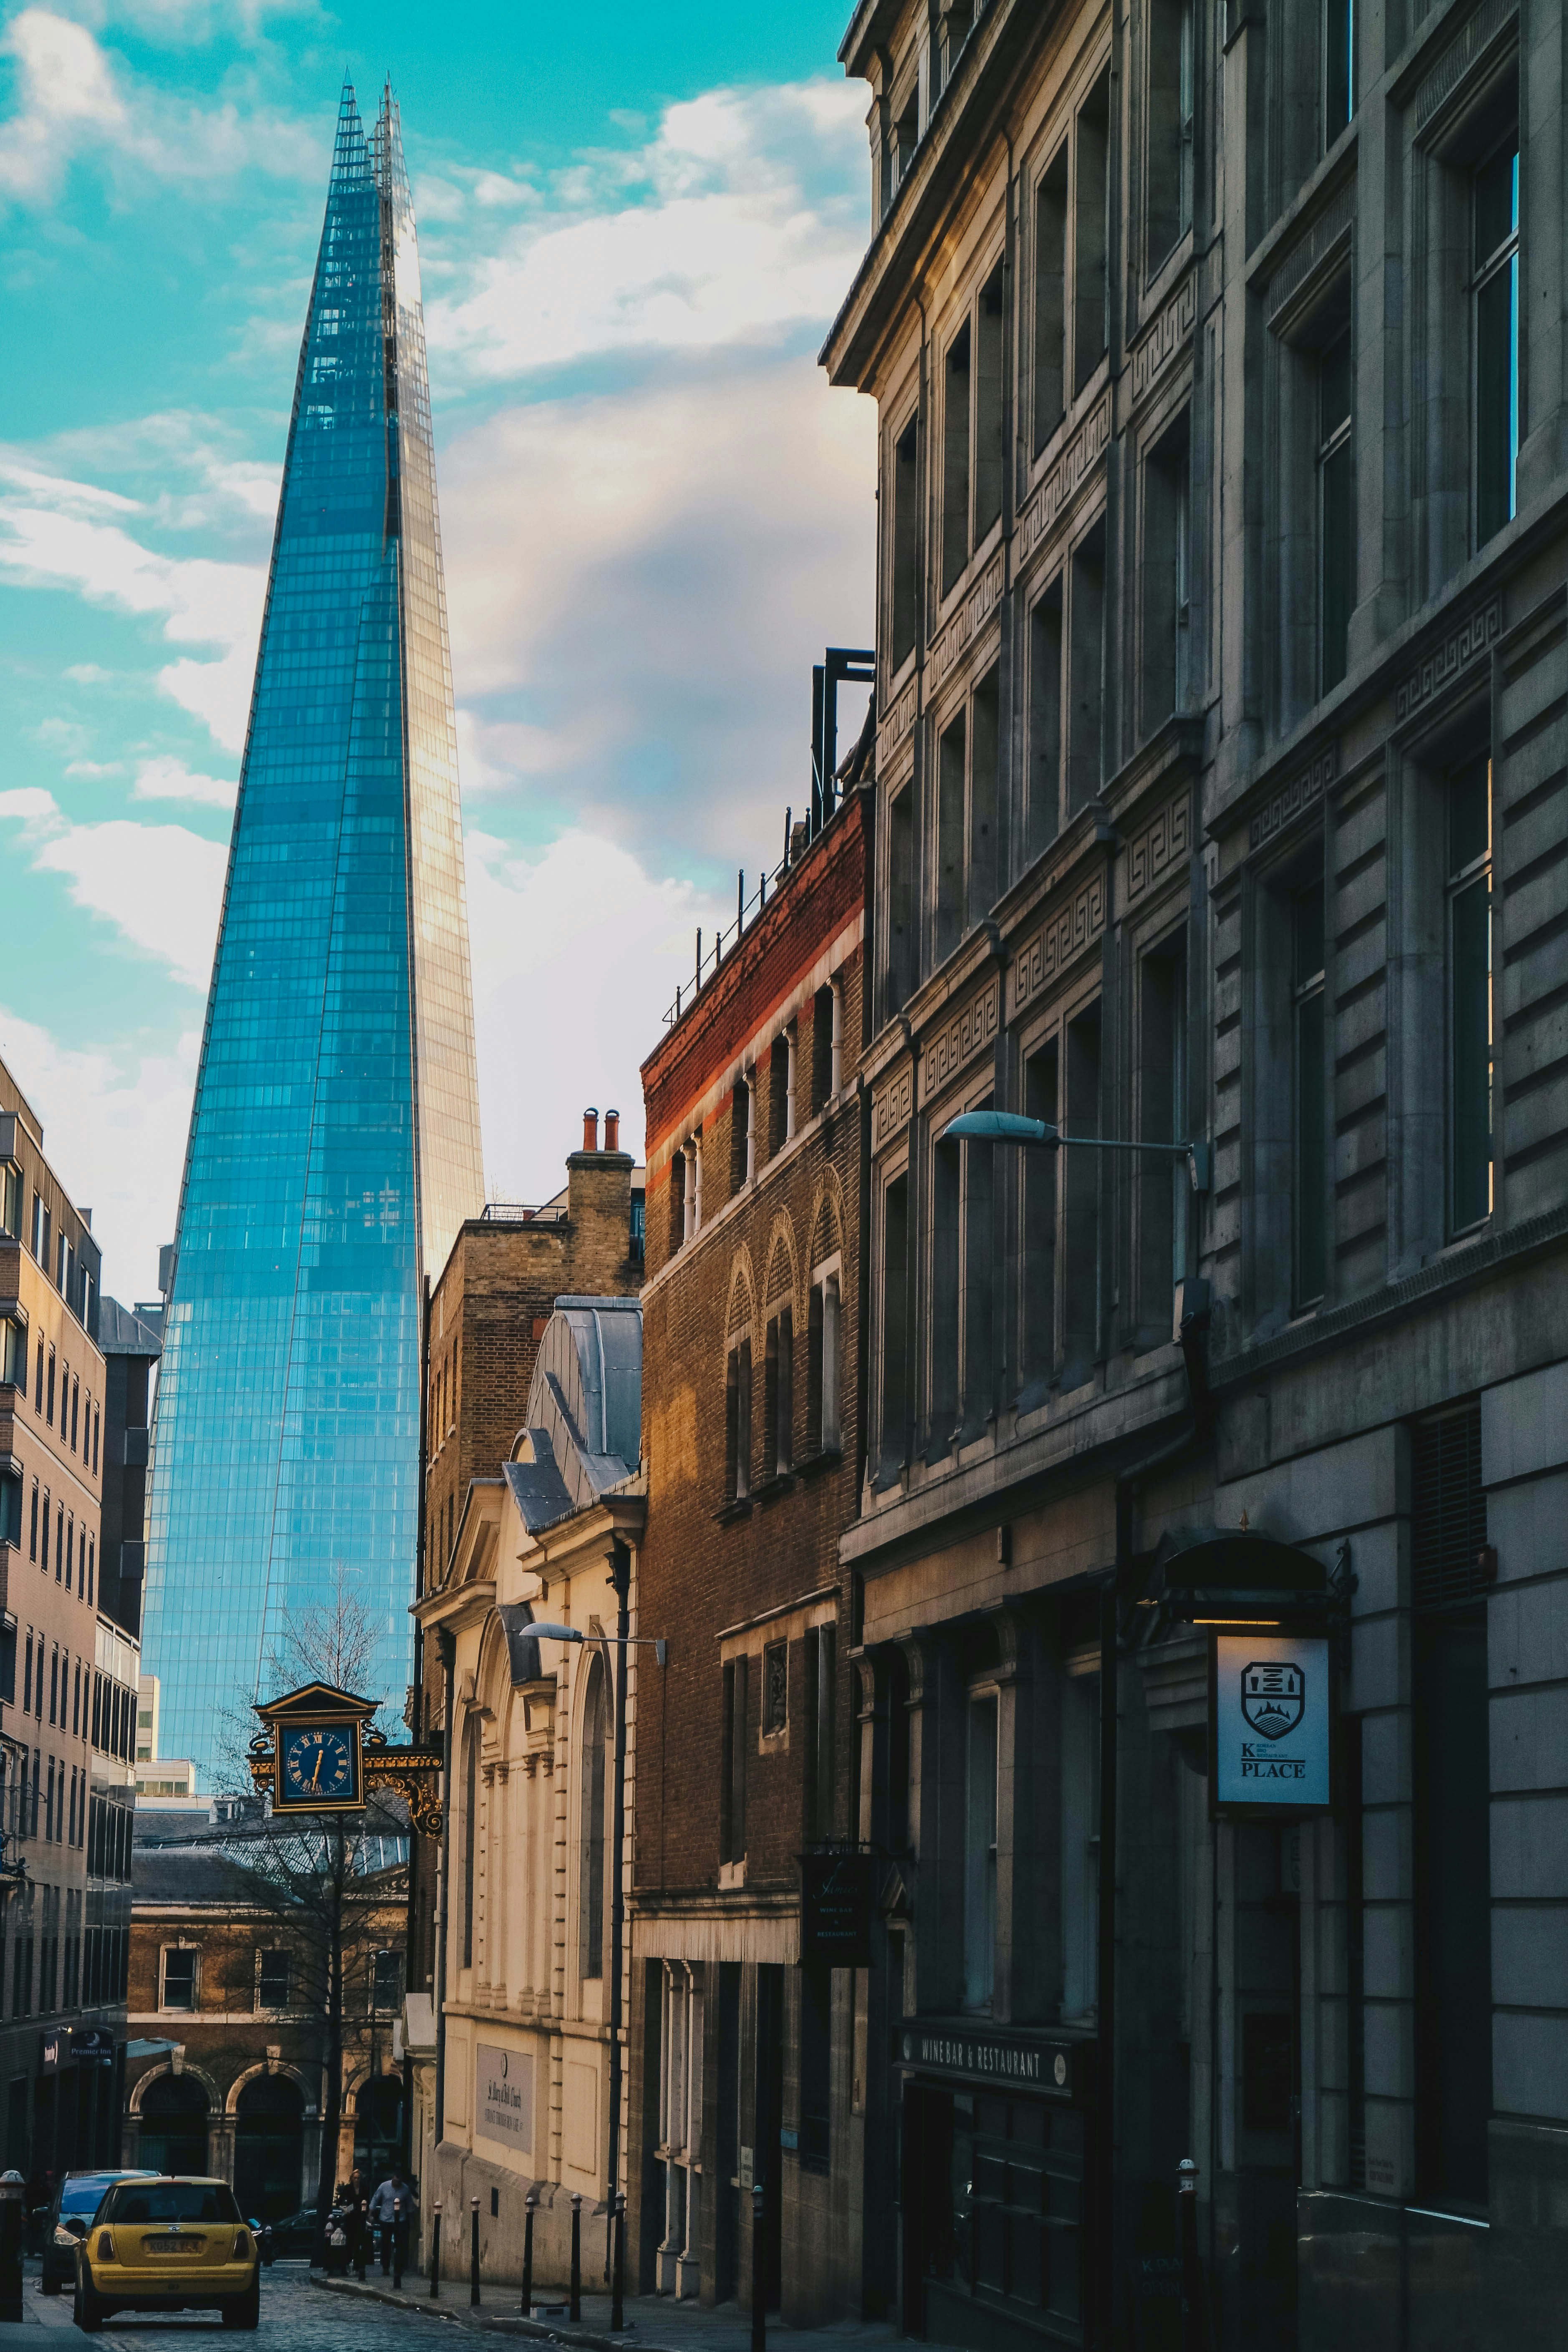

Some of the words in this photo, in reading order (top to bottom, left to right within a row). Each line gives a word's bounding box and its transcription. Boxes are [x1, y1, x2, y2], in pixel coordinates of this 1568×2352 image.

[313, 1734, 323, 1744] XII
[1241, 1743, 1255, 1757] K
[1241, 1763, 1305, 1778] PLACE
[922, 2038, 943, 2063] WINE
[946, 2041, 963, 2066] BAR
[968, 2045, 973, 2068] &
[978, 2045, 1040, 2078] RESTAURANT
